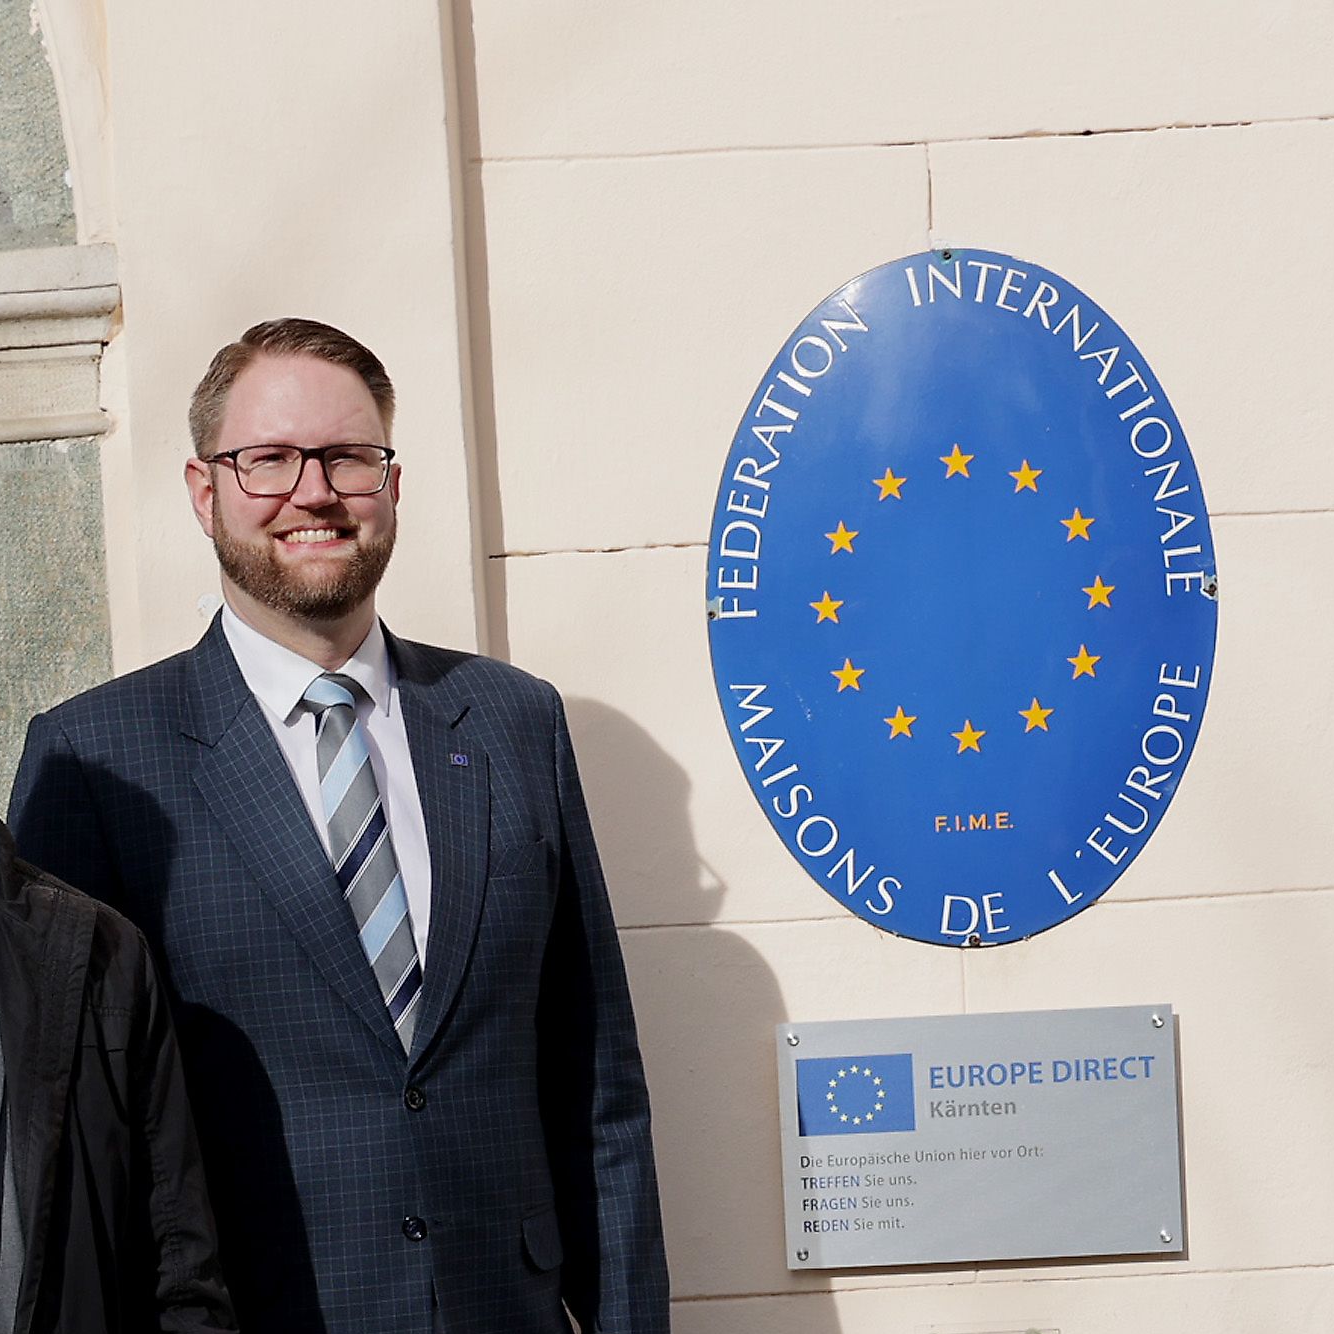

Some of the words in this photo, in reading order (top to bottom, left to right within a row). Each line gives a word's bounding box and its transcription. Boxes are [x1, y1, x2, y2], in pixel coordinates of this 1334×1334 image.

[718, 300, 869, 619] FEDERATION
[904, 260, 1205, 597] INTERNATIONALE
[730, 683, 903, 916] MAISONS
[939, 893, 1011, 937] DE
[934, 812, 1014, 833] F.I.M.E.
[929, 1061, 1043, 1089] EUROPE
[1052, 1055, 1155, 1083] DIRECT
[930, 1098, 1017, 1119] Kärnten
[800, 1155, 823, 1169] Die
[827, 1152, 910, 1169] Europäische
[915, 1150, 955, 1164] Union
[960, 1147, 986, 1160] hier
[991, 1149, 1012, 1159] vor
[1017, 1145, 1044, 1158] Ort:
[801, 1175, 860, 1190] TREFFEN
[864, 1173, 884, 1187] Sie
[889, 1175, 917, 1186] uns.
[803, 1197, 857, 1212] FRAGEN
[862, 1196, 881, 1209] Sie
[886, 1197, 914, 1208] uns.
[804, 1219, 849, 1233] REDEN
[854, 1218, 873, 1231] Sie
[878, 1217, 905, 1230] mit.
